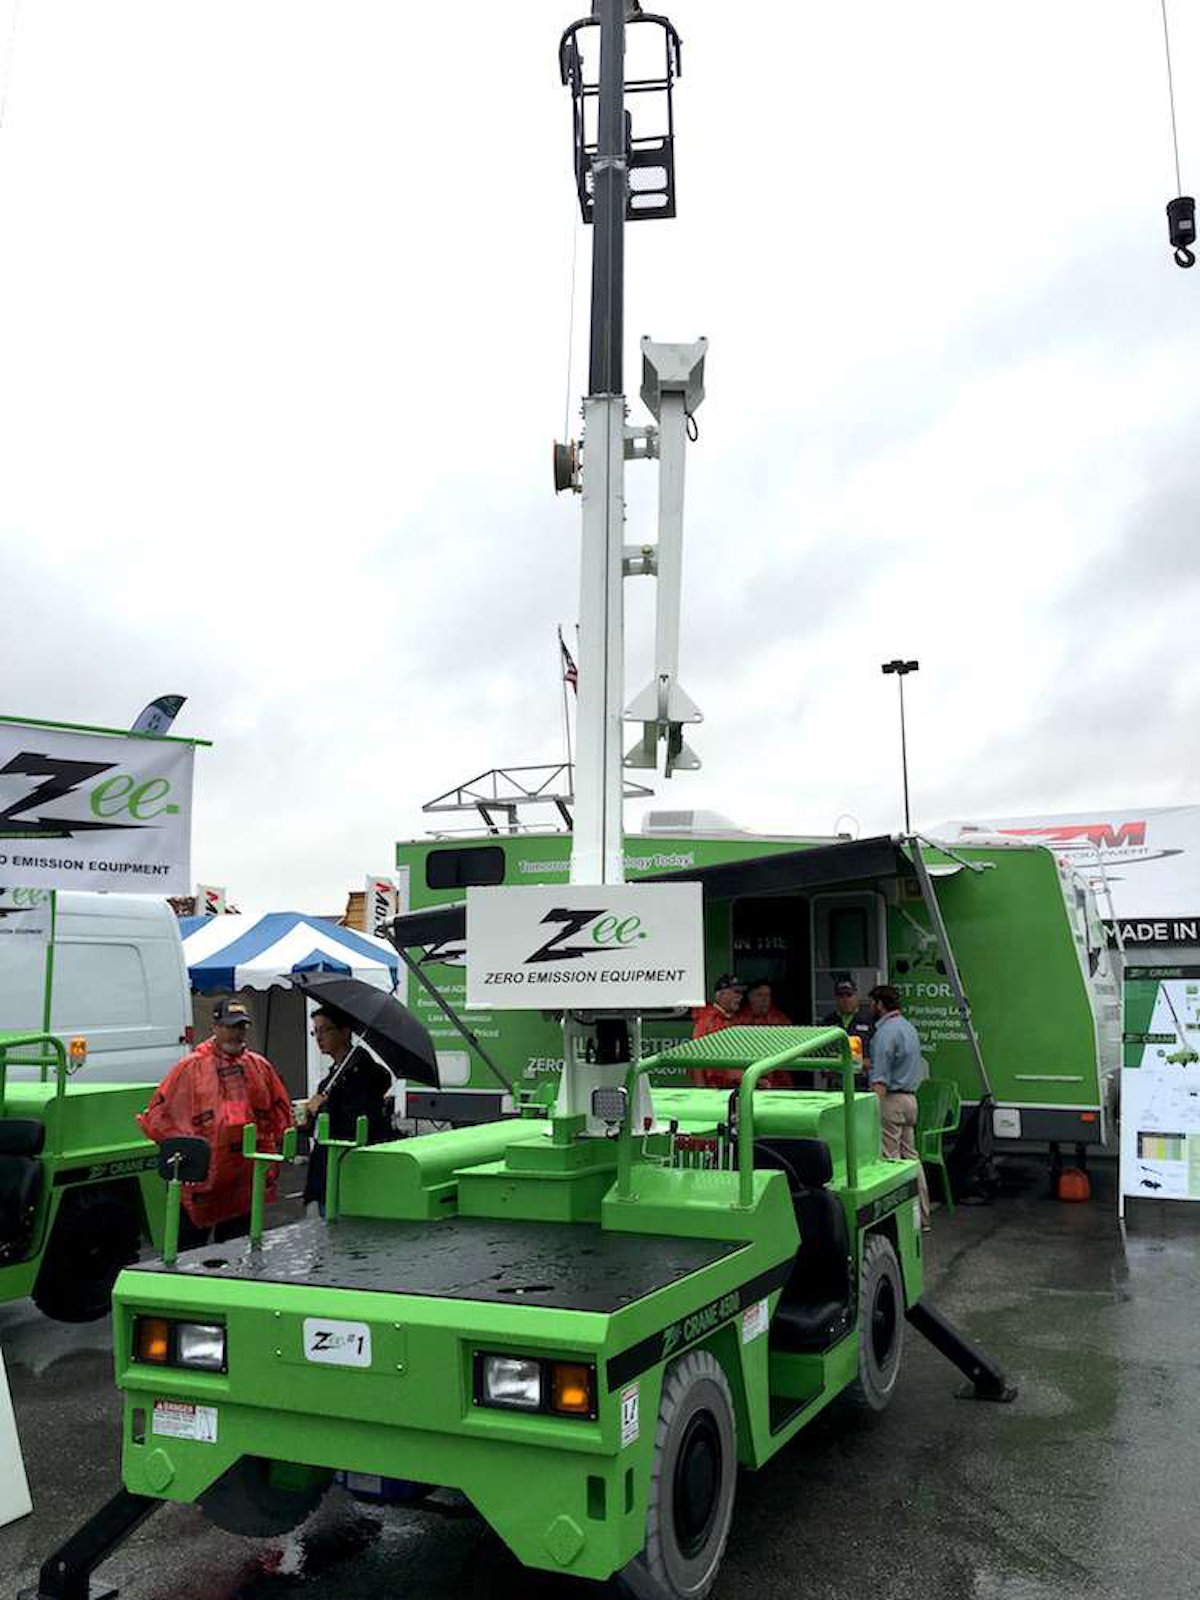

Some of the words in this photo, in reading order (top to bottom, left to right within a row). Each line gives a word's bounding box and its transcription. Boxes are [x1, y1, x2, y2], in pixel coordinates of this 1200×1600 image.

[12, 855, 84, 871] EMISSION
[89, 861, 170, 876] EQUIPMENT
[1102, 923, 1169, 941] MADE
[1173, 921, 1198, 940] IN
[484, 972, 524, 985] ZERO
[527, 971, 597, 984] EMISSION
[599, 969, 686, 983] EQUIPMENT
